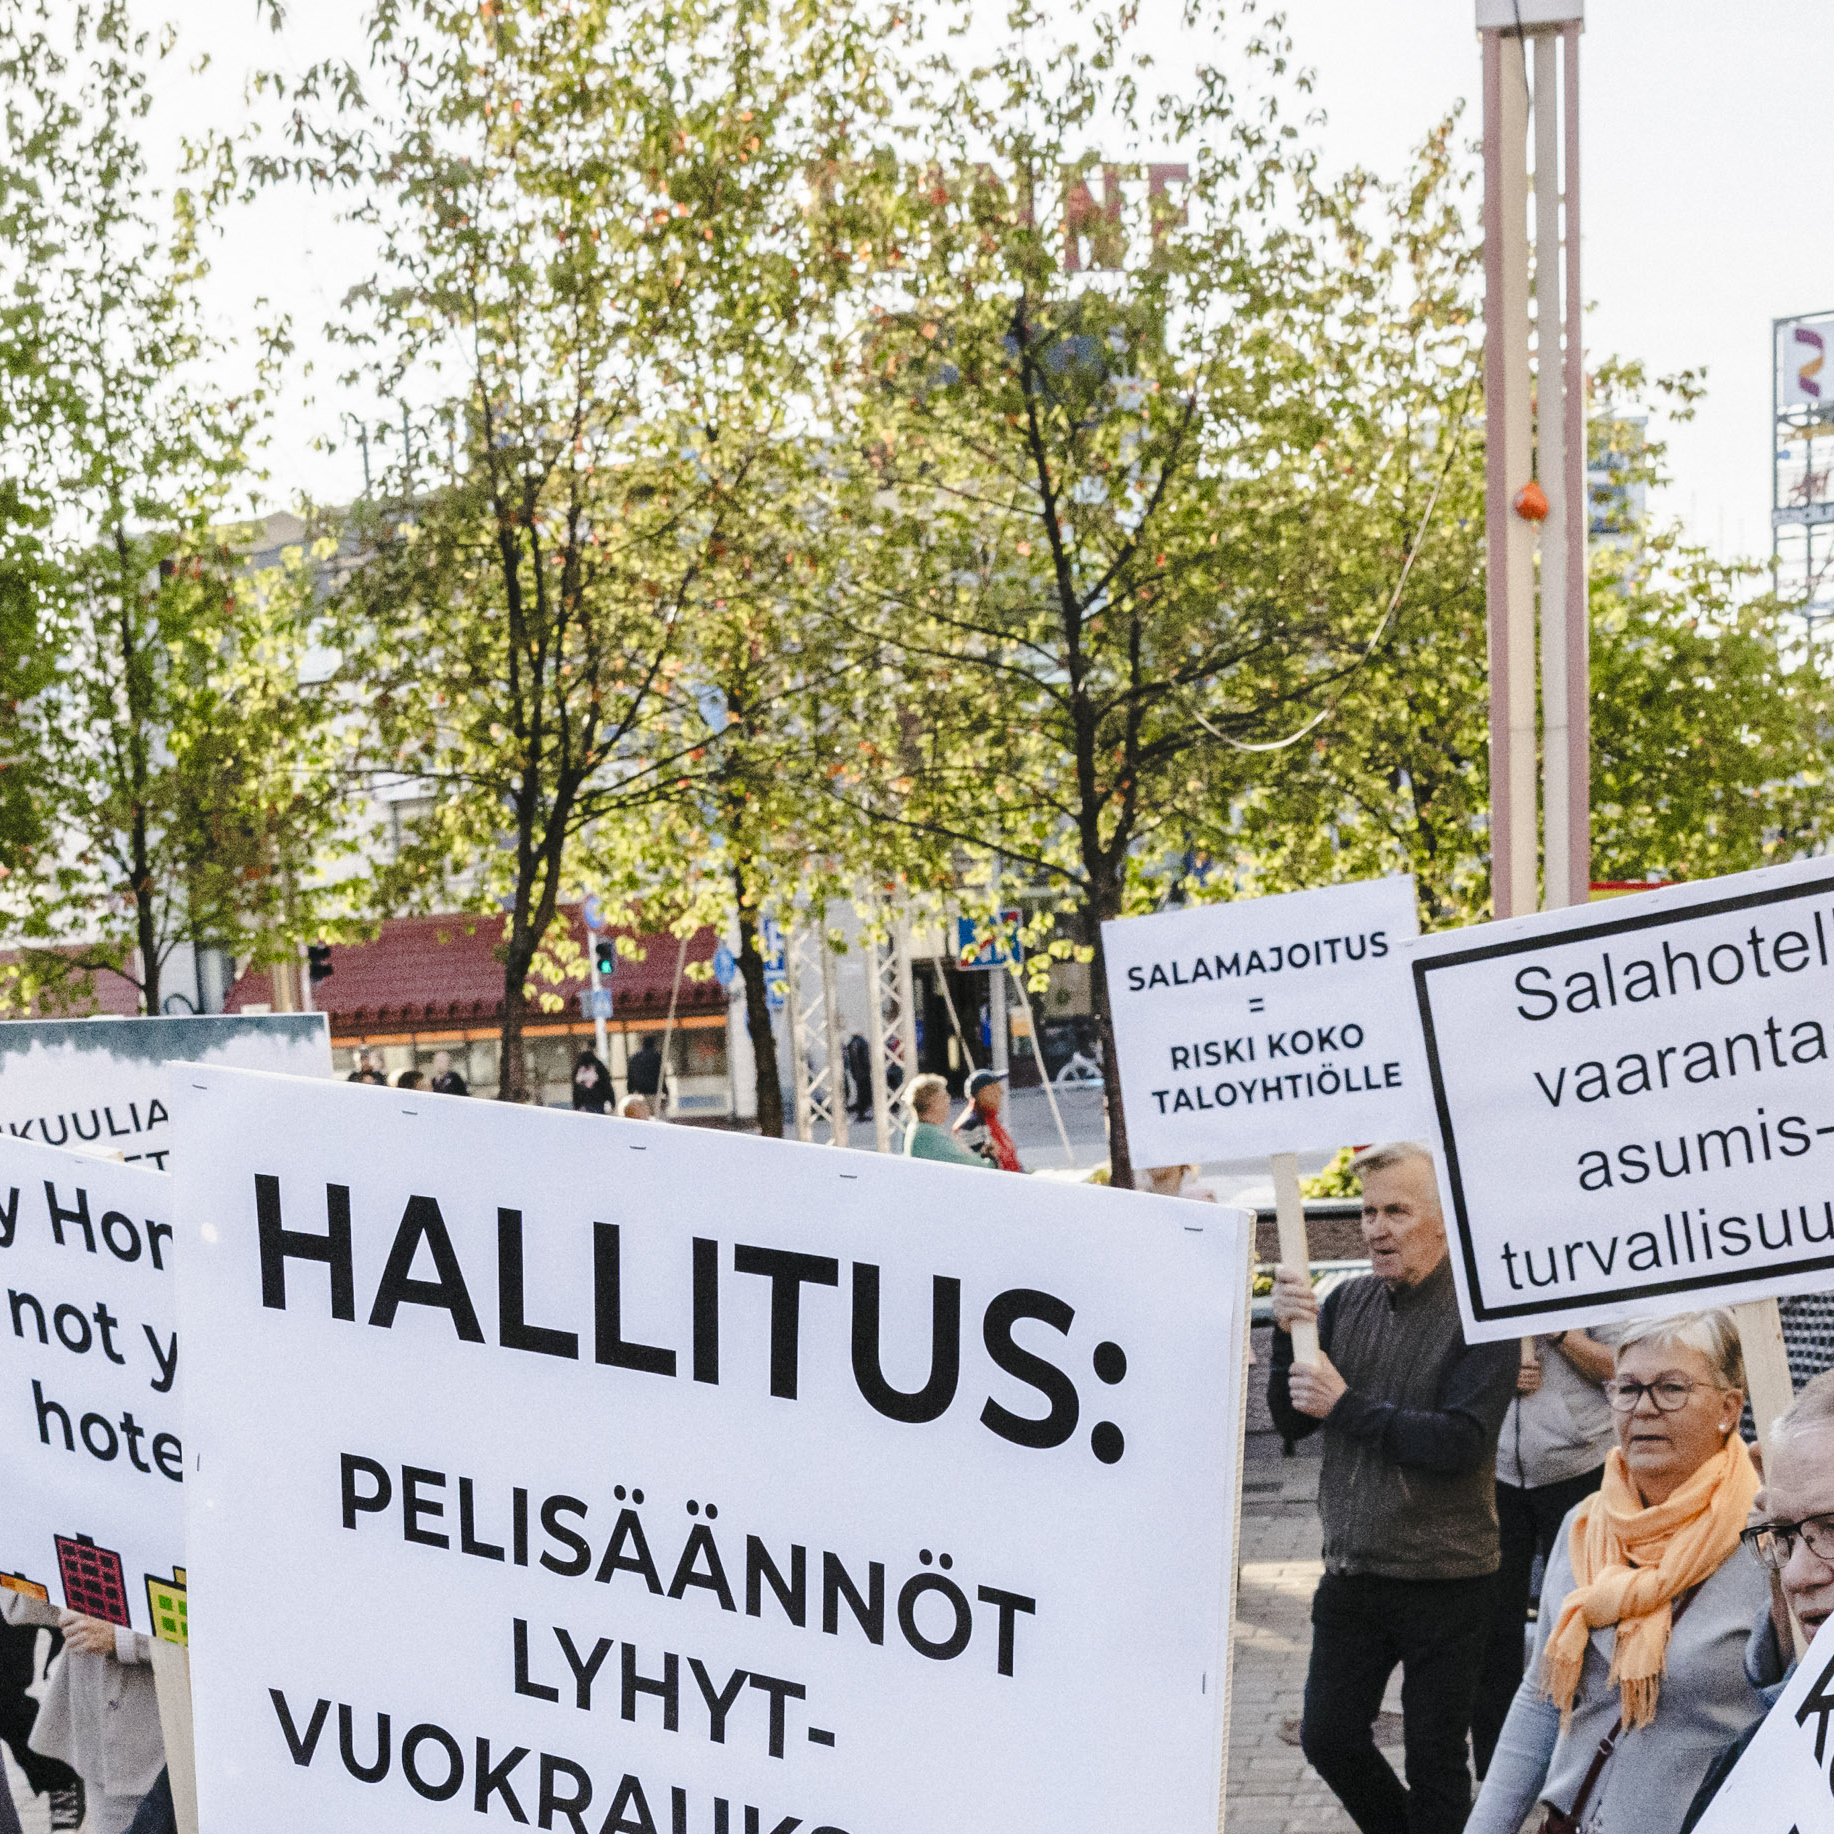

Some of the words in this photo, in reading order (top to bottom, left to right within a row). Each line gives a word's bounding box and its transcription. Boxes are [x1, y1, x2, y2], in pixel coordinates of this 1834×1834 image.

[1127, 931, 1390, 992] SALAMAJOITUS
[1151, 1061, 1404, 1116] TALOYHTIÖLLE
[1170, 1035, 1257, 1072] RISKI
[1268, 1022, 1366, 1060] KOKO
[7, 1288, 126, 1366] not
[254, 1173, 1128, 1465] HALLITUS:
[31, 1378, 184, 1483] hote
[340, 1452, 1036, 1677] PELISÄÄNNÖT
[513, 1617, 836, 1759] LYHYT-
